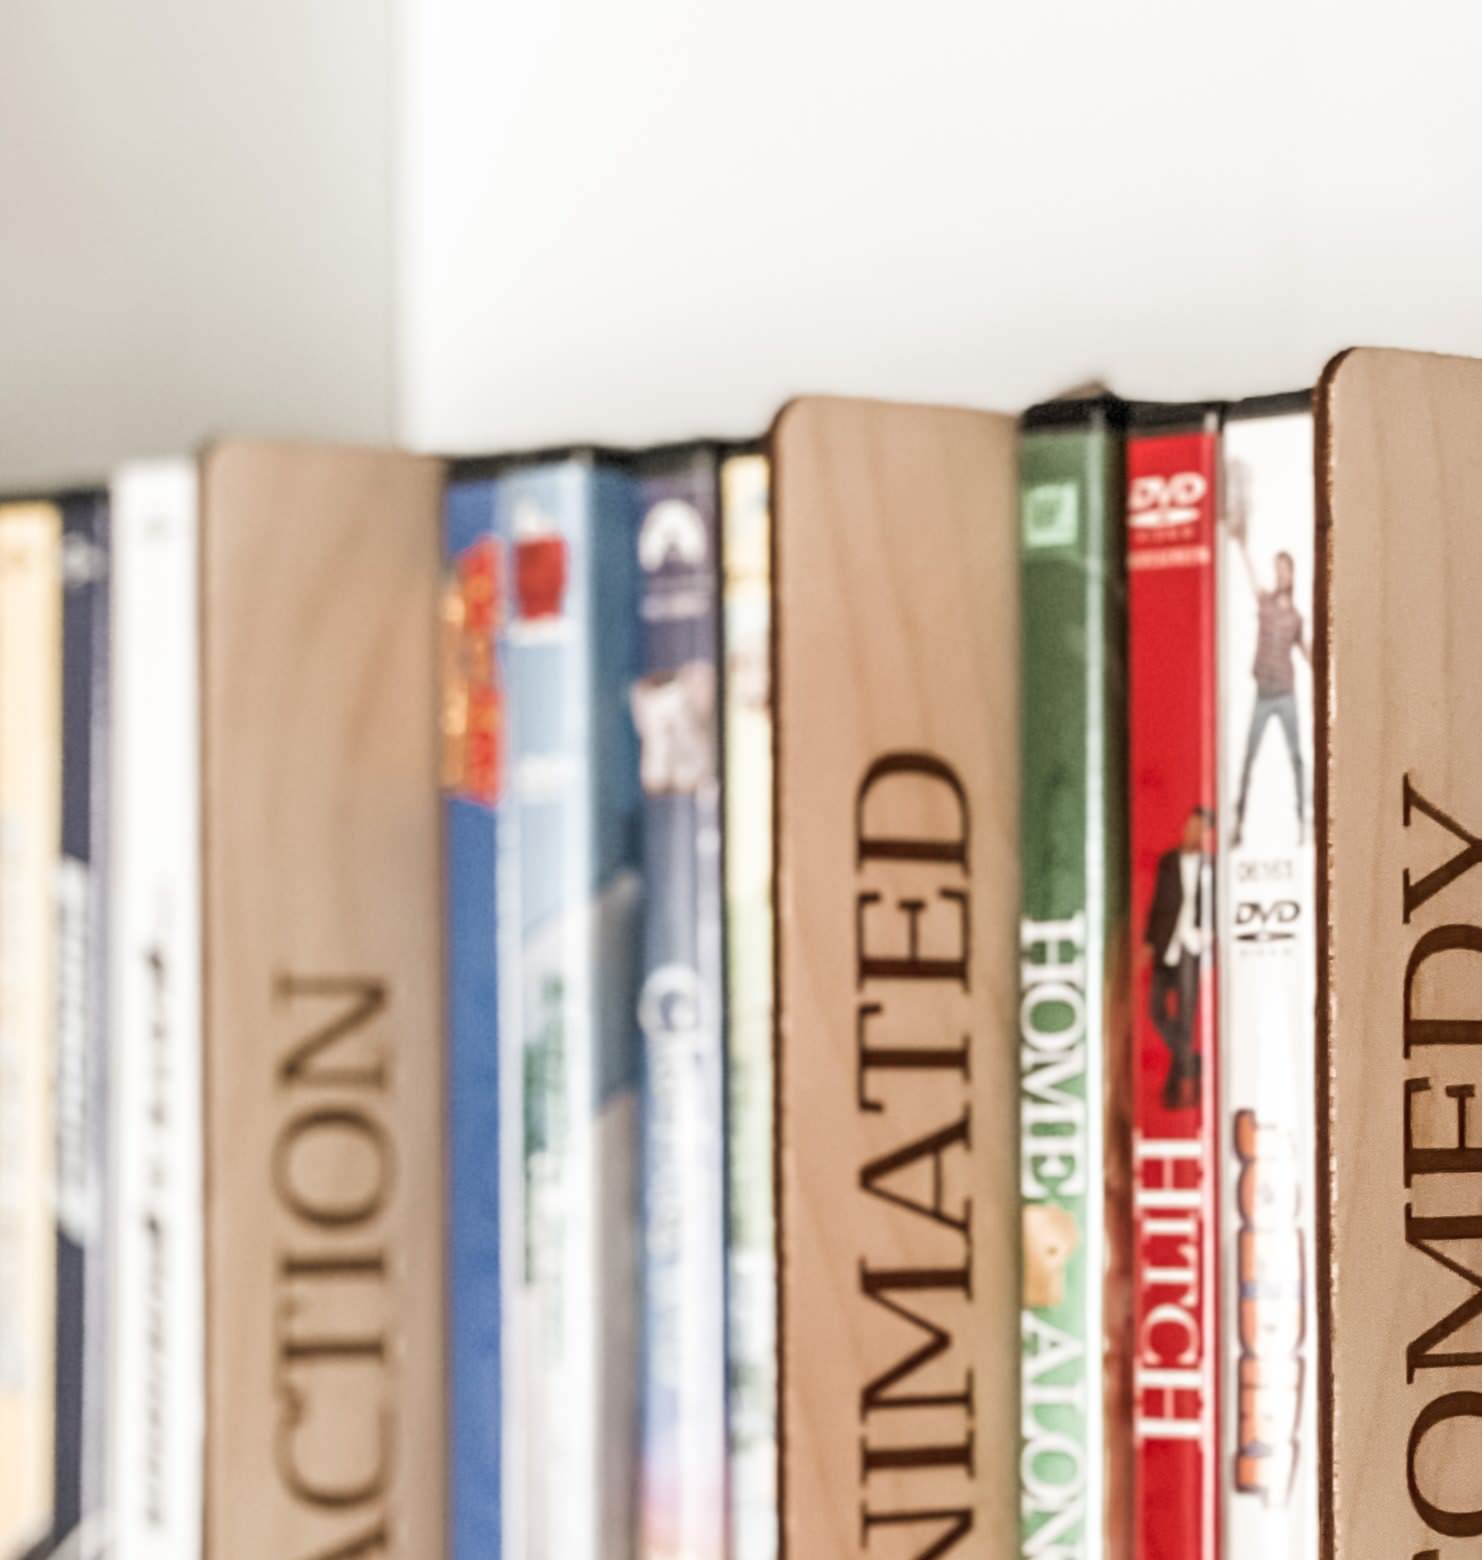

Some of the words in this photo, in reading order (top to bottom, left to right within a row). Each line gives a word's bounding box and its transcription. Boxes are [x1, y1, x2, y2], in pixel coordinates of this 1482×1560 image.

[1129, 473, 1207, 511] DVD
[1235, 899, 1301, 929] DVD
[1019, 912, 1086, 1200] HOME
[1133, 1128, 1206, 1446] HITCH
